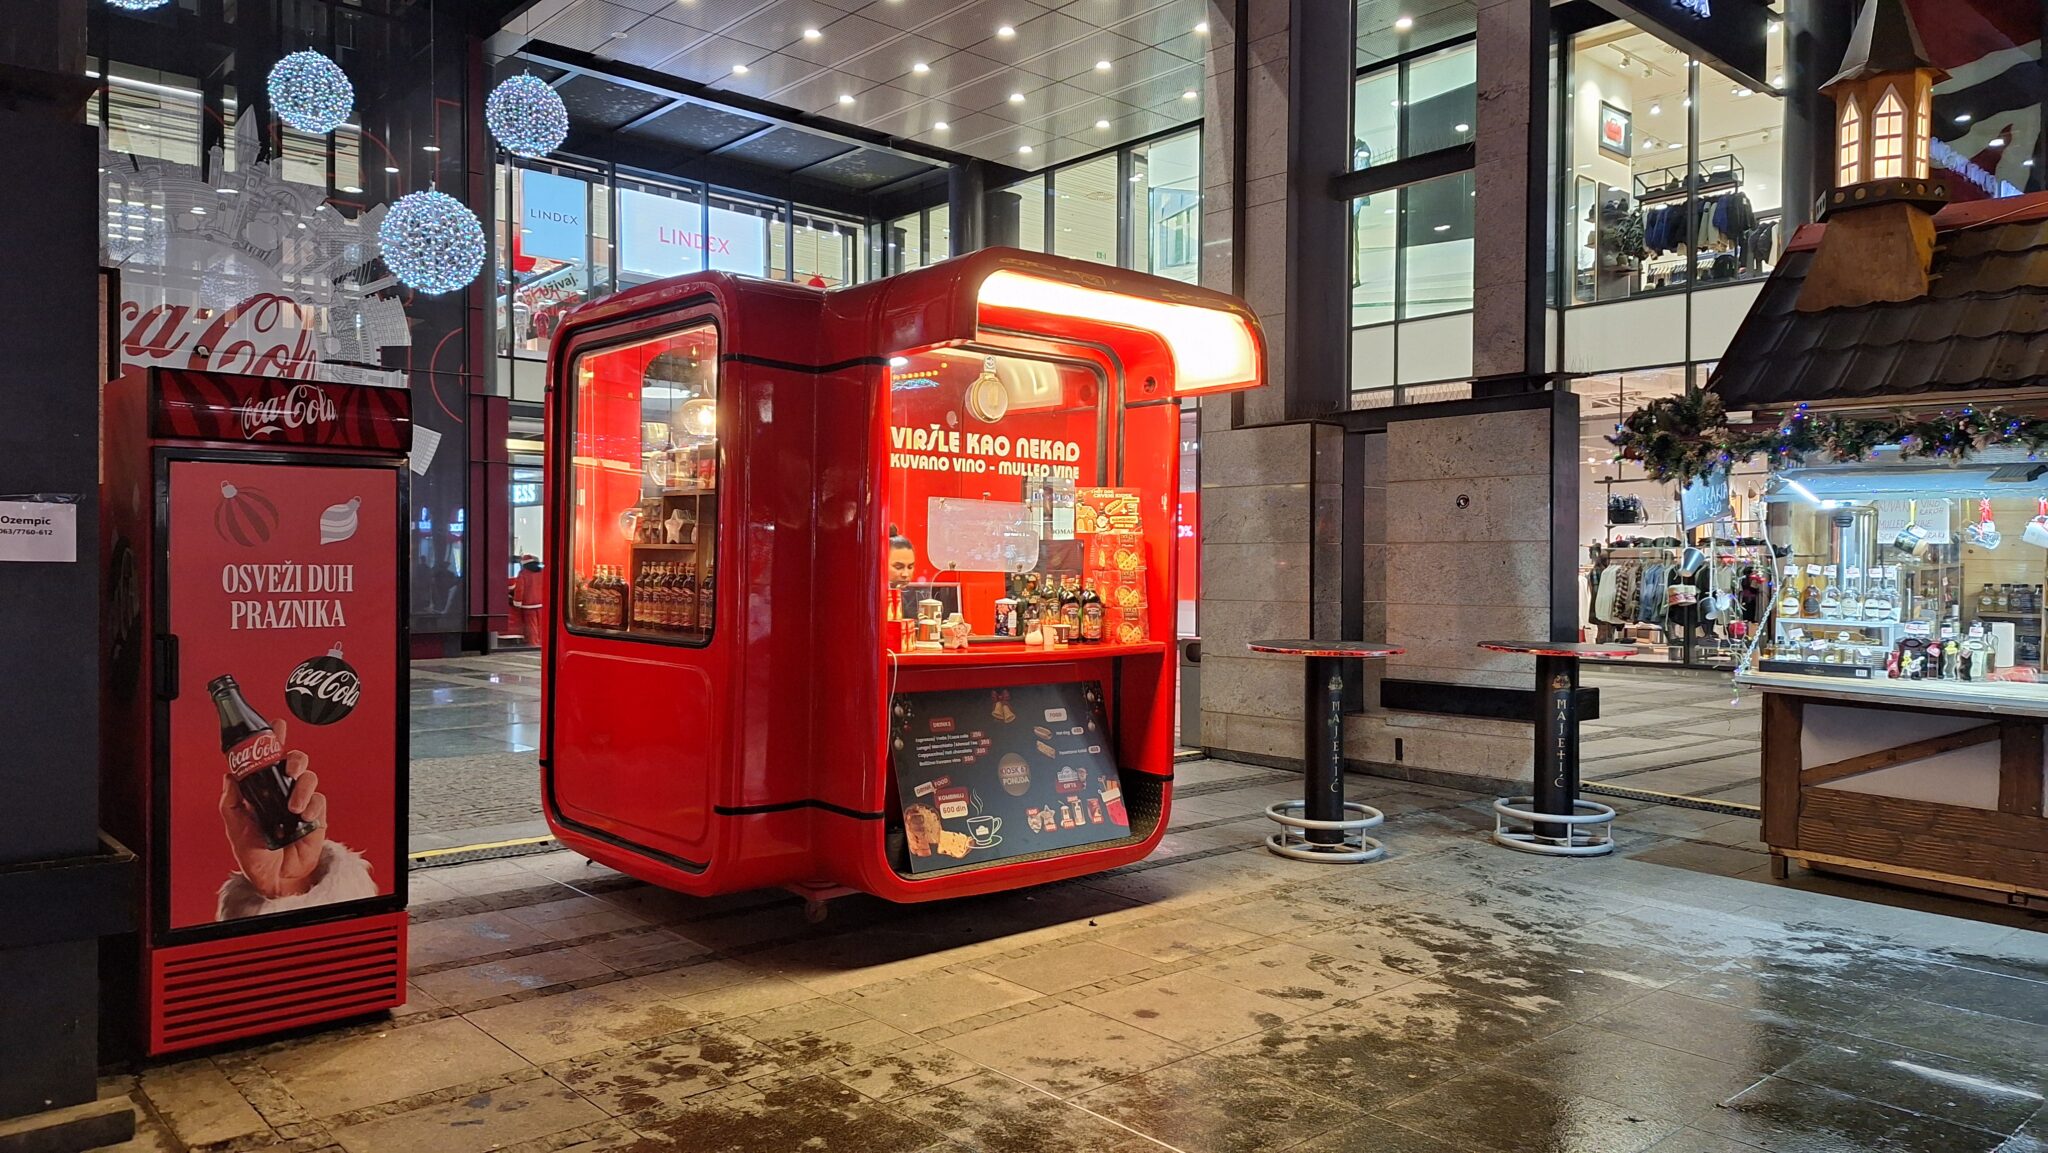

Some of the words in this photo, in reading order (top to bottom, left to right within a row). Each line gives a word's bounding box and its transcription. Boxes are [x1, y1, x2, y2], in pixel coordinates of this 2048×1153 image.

[530, 208, 578, 226] LINDEX
[659, 226, 730, 255] LINDEX
[241, 384, 338, 440] Coca-Cola
[890, 423, 960, 454] VIRŠLE
[966, 432, 1011, 457] KAO
[1016, 437, 1080, 462] NEKAD
[890, 453, 950, 471] KUVANO
[952, 457, 986, 474] VINO
[1052, 464, 1080, 480] VINE
[0, 515, 52, 527] Ozempic
[222, 560, 303, 594] OSVEŽI
[307, 564, 354, 593] DUH
[230, 599, 347, 630] PRAZNIKA
[285, 662, 361, 707] Coca-Cola
[229, 734, 281, 774] Coca-Cola
[1003, 776, 1030, 785] PONUDA
[942, 805, 956, 814] 600
